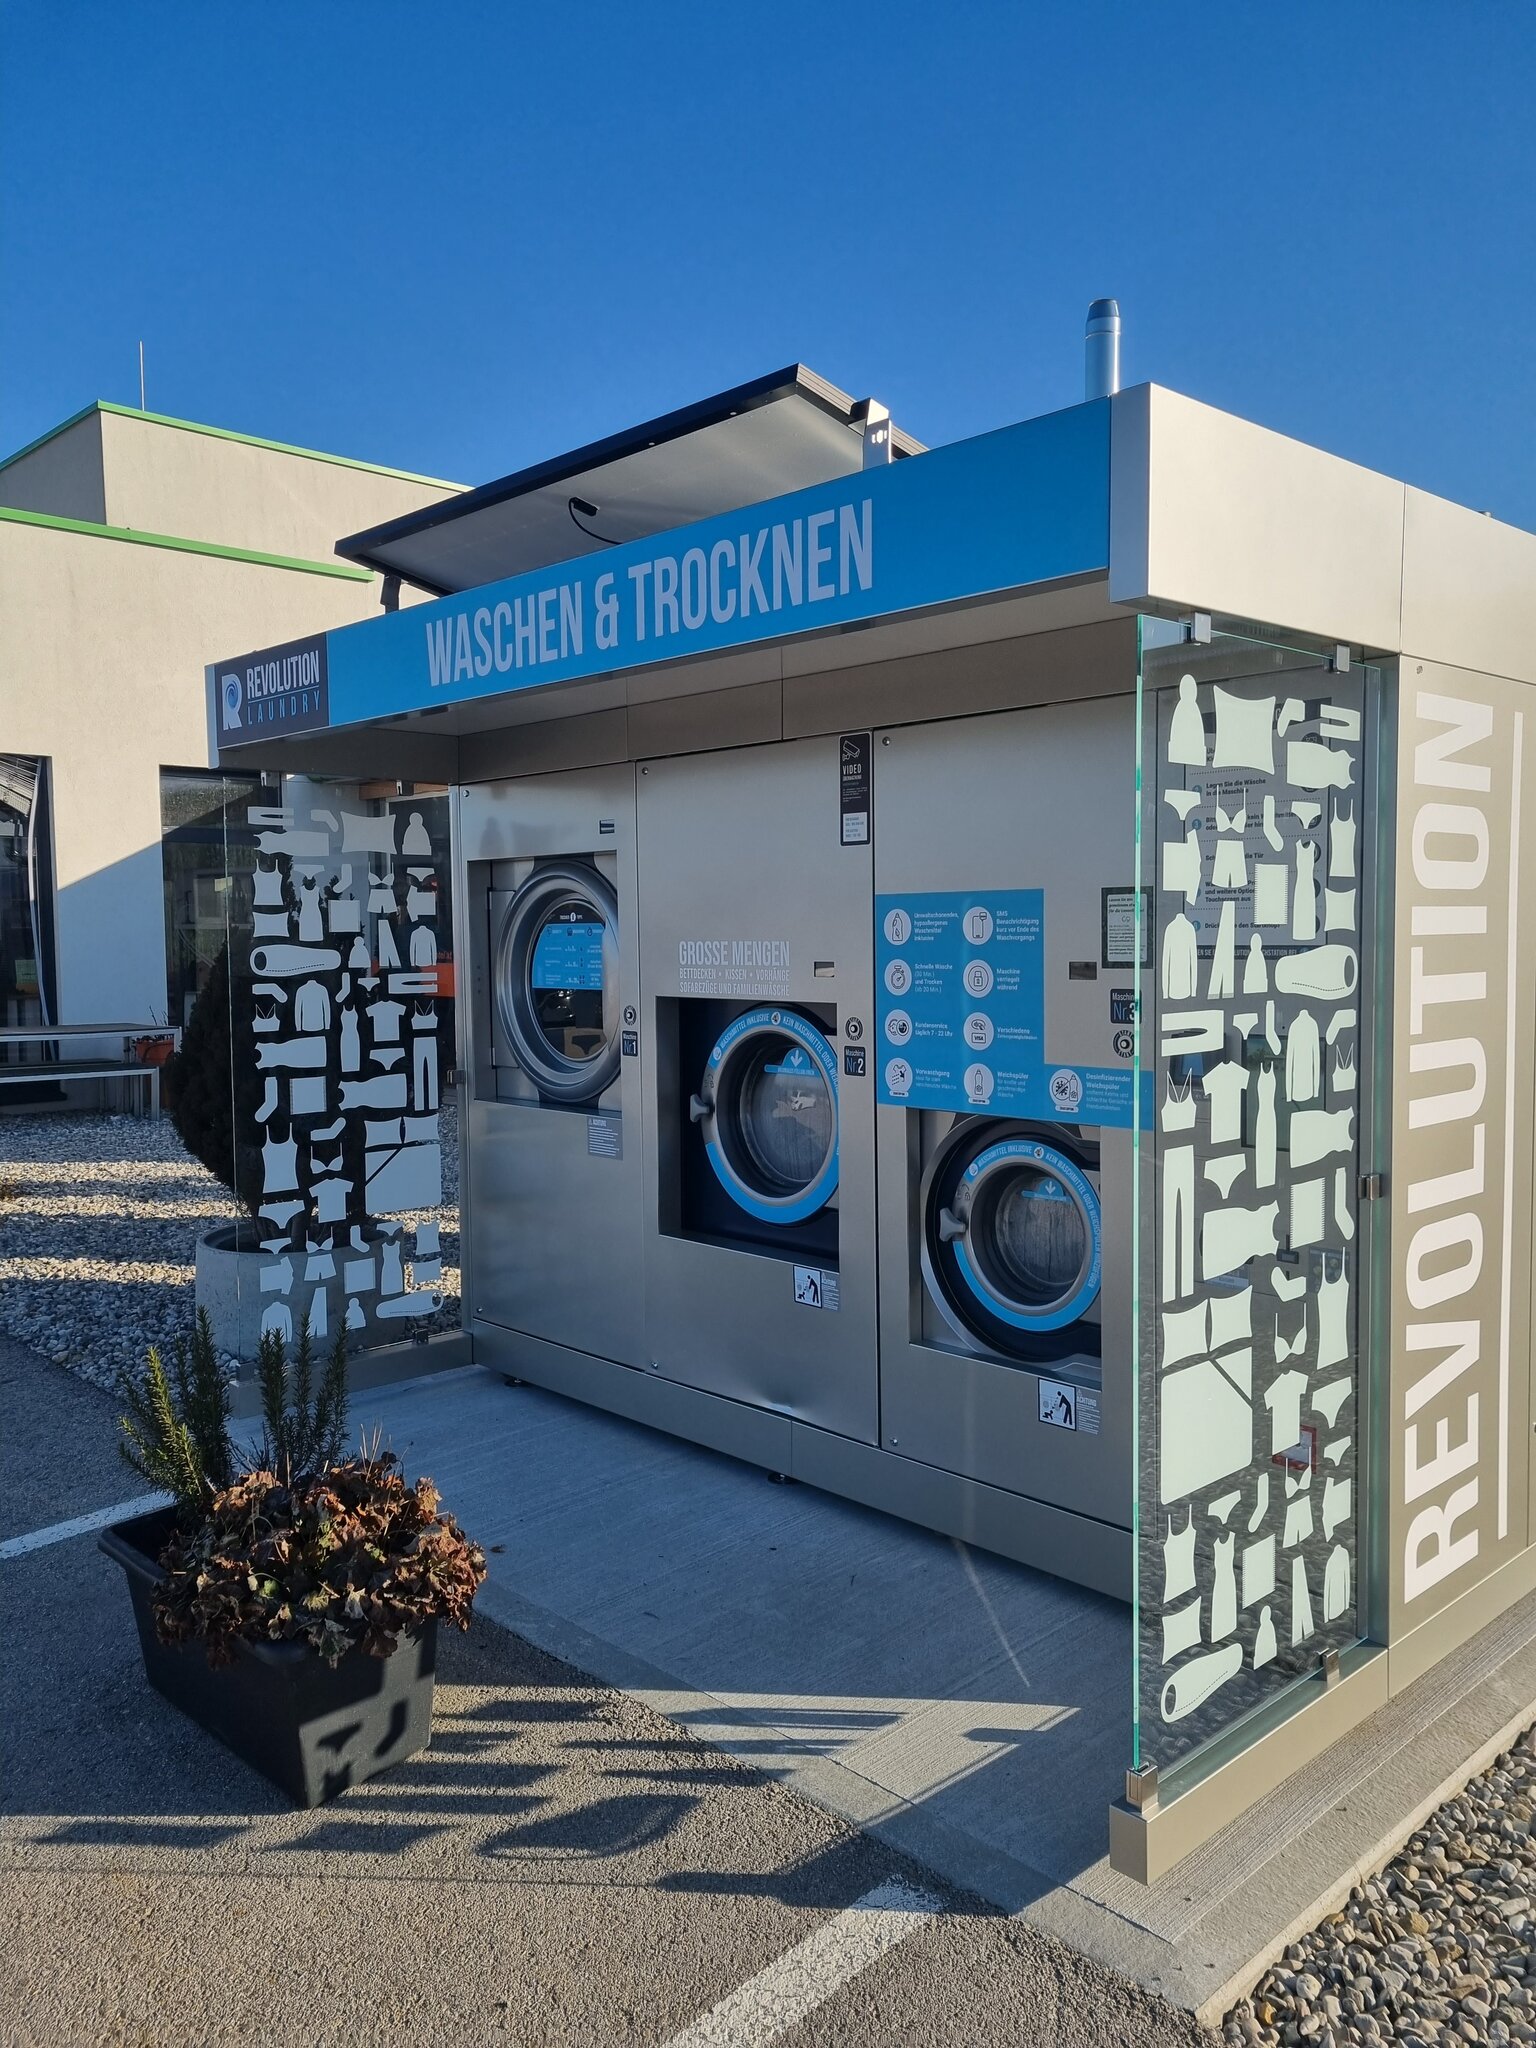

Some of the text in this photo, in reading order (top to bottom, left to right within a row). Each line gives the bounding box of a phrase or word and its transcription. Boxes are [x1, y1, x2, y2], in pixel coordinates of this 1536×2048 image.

[426, 498, 873, 687] WASCHEN & TROCKNEN
[246, 650, 320, 699] REVOLUTION
[247, 690, 320, 725] LAUNDRY
[842, 763, 862, 776] VIDEO
[680, 940, 790, 966] GROSSE MENGEN
[680, 967, 790, 981] BETTDECKEN KISSEN VORHÄNGE
[680, 980, 790, 996] SOFABEZÜGE UND FAMILIENWÄSCHE
[1112, 992, 1135, 1000] Maschin
[746, 1012, 769, 1024] INKLUSIVE
[783, 1015, 794, 1027] KEIN
[794, 1020, 823, 1055] WASCHMITTEL
[821, 1050, 834, 1070] ODER
[846, 1057, 864, 1074] Nr.2
[1404, 691, 1493, 1605] REVOLUTION
[1046, 1152, 1058, 1164] KEIN
[1057, 1159, 1086, 1196] WASCHMITTEL
[1083, 1192, 1095, 1211] ODER
